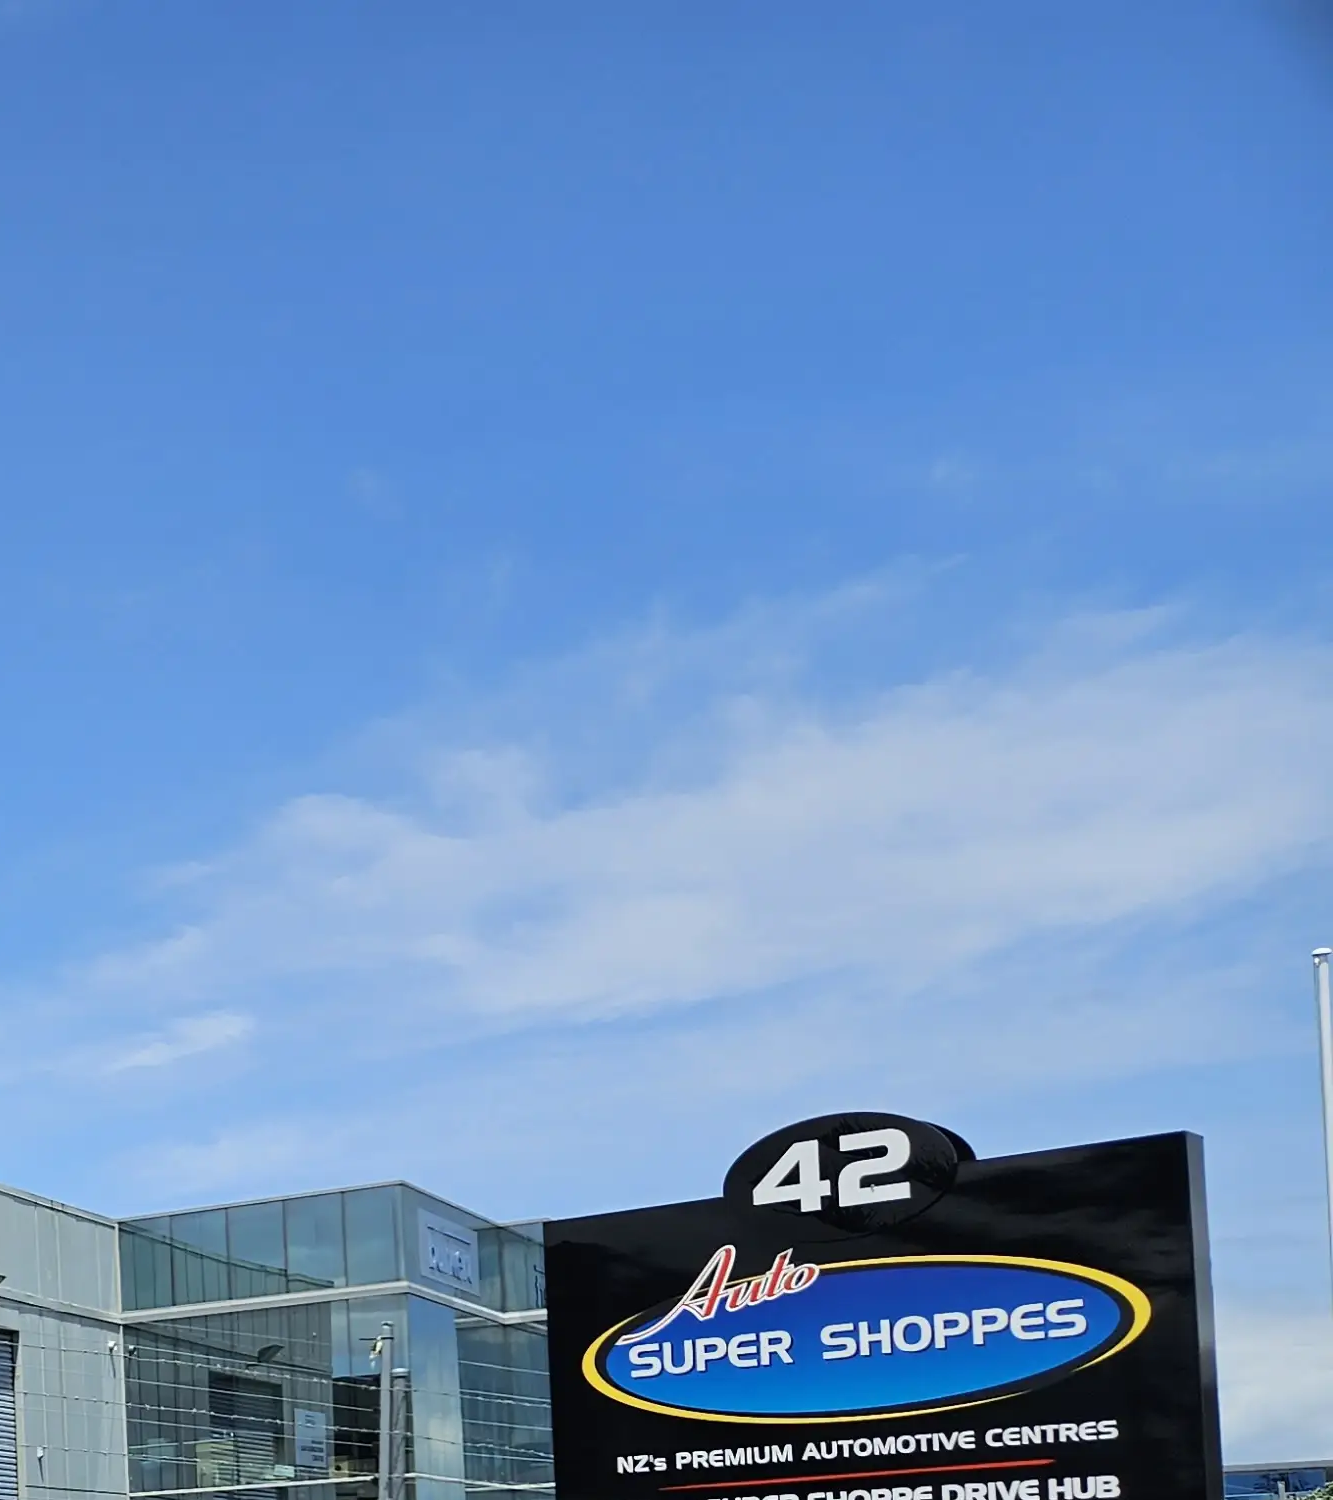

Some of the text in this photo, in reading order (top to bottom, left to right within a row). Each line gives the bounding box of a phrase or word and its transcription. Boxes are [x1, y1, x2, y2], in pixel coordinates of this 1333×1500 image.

[753, 1129, 911, 1212] 42
[615, 1244, 820, 1346] Auto
[629, 1299, 1086, 1377] SUPER SHOPPES
[618, 1420, 1118, 1473] NZ's PREMIUM AUTOMOTIVE CENTRES
[1049, 1476, 1120, 1500] HUB
